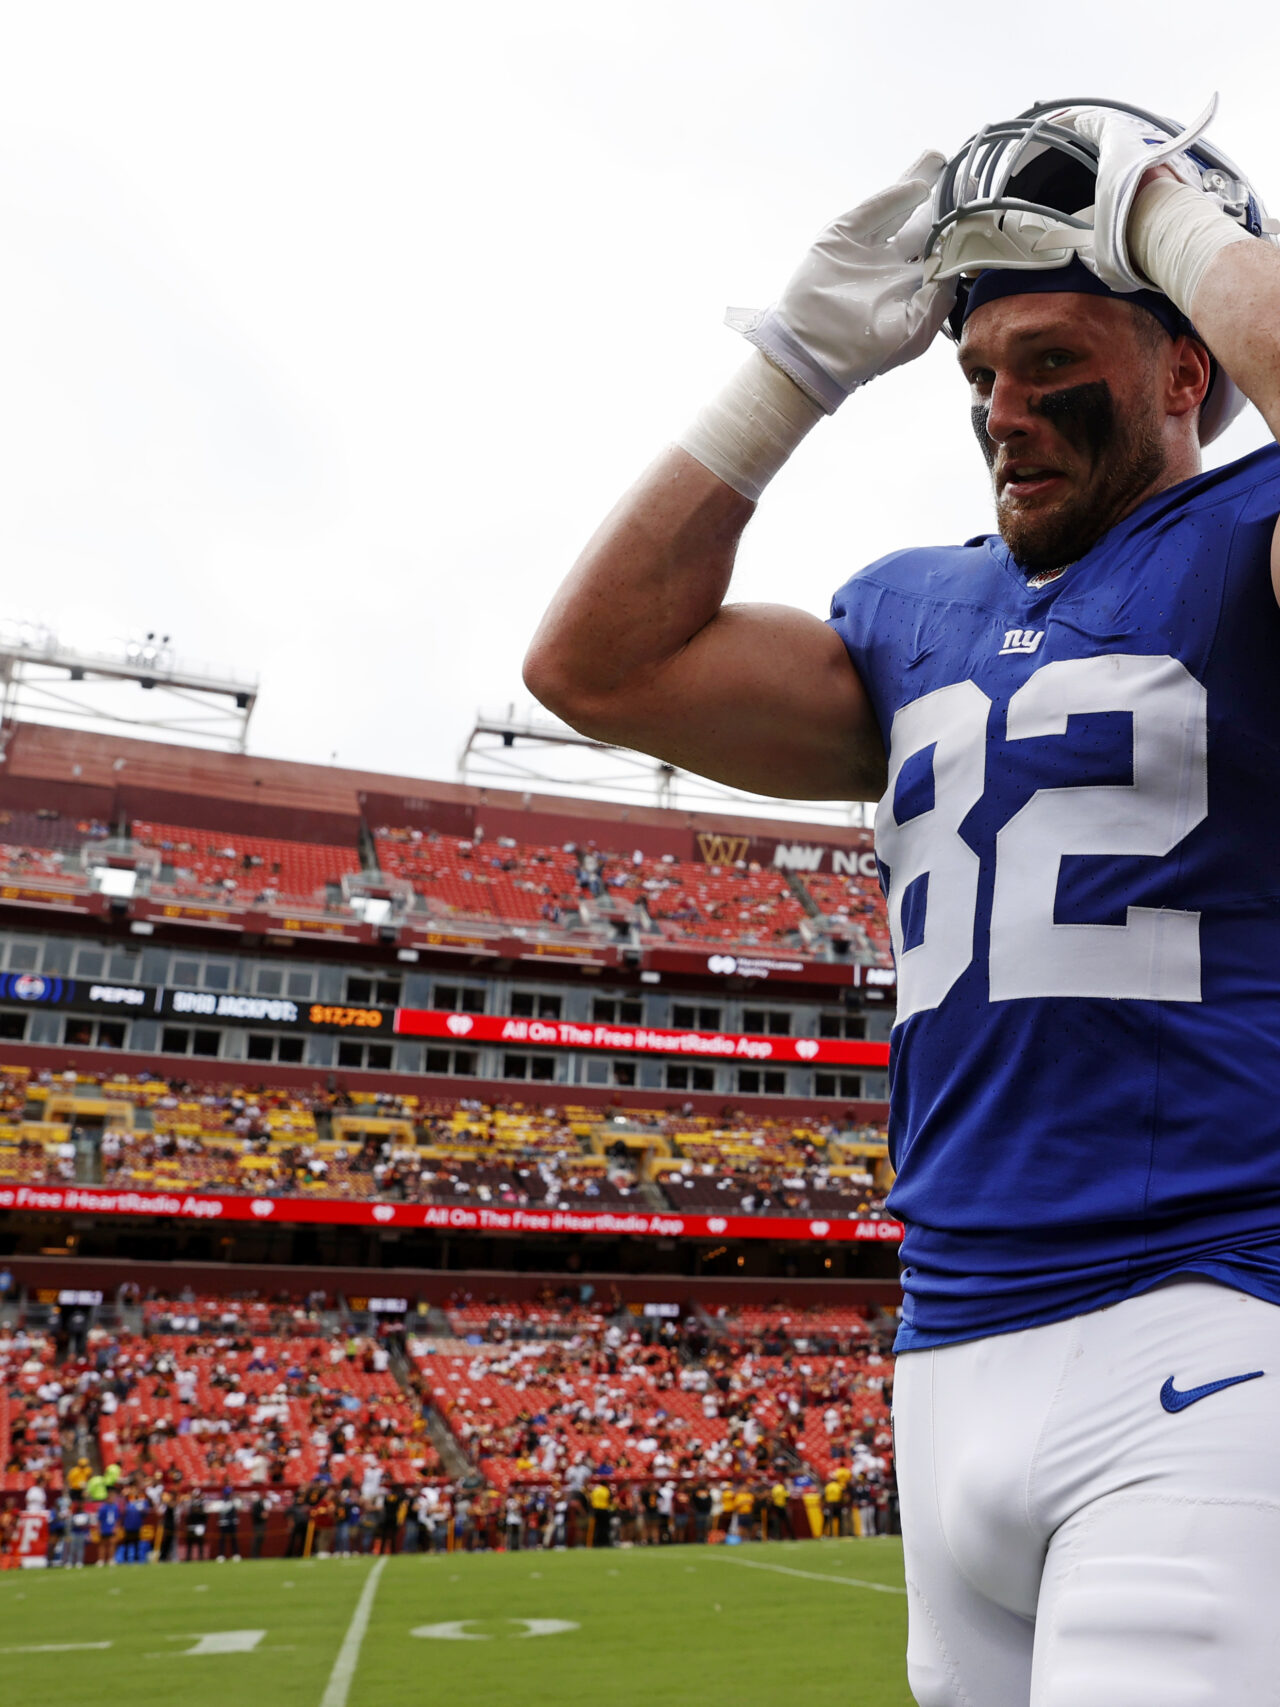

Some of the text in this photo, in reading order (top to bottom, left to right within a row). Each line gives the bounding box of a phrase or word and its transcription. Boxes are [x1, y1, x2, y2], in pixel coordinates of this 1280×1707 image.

[874, 654, 1208, 1029] 82
[90, 986, 145, 1005] PEPSI
[502, 1020, 773, 1059] All On The Free iHeartRadio App
[16, 1187, 62, 1208] Free
[64, 1189, 180, 1213] iHeartRadio
[182, 1196, 223, 1218] App
[425, 1207, 685, 1236] All On The Free iHeartRadio App
[855, 1222, 900, 1238] All On
